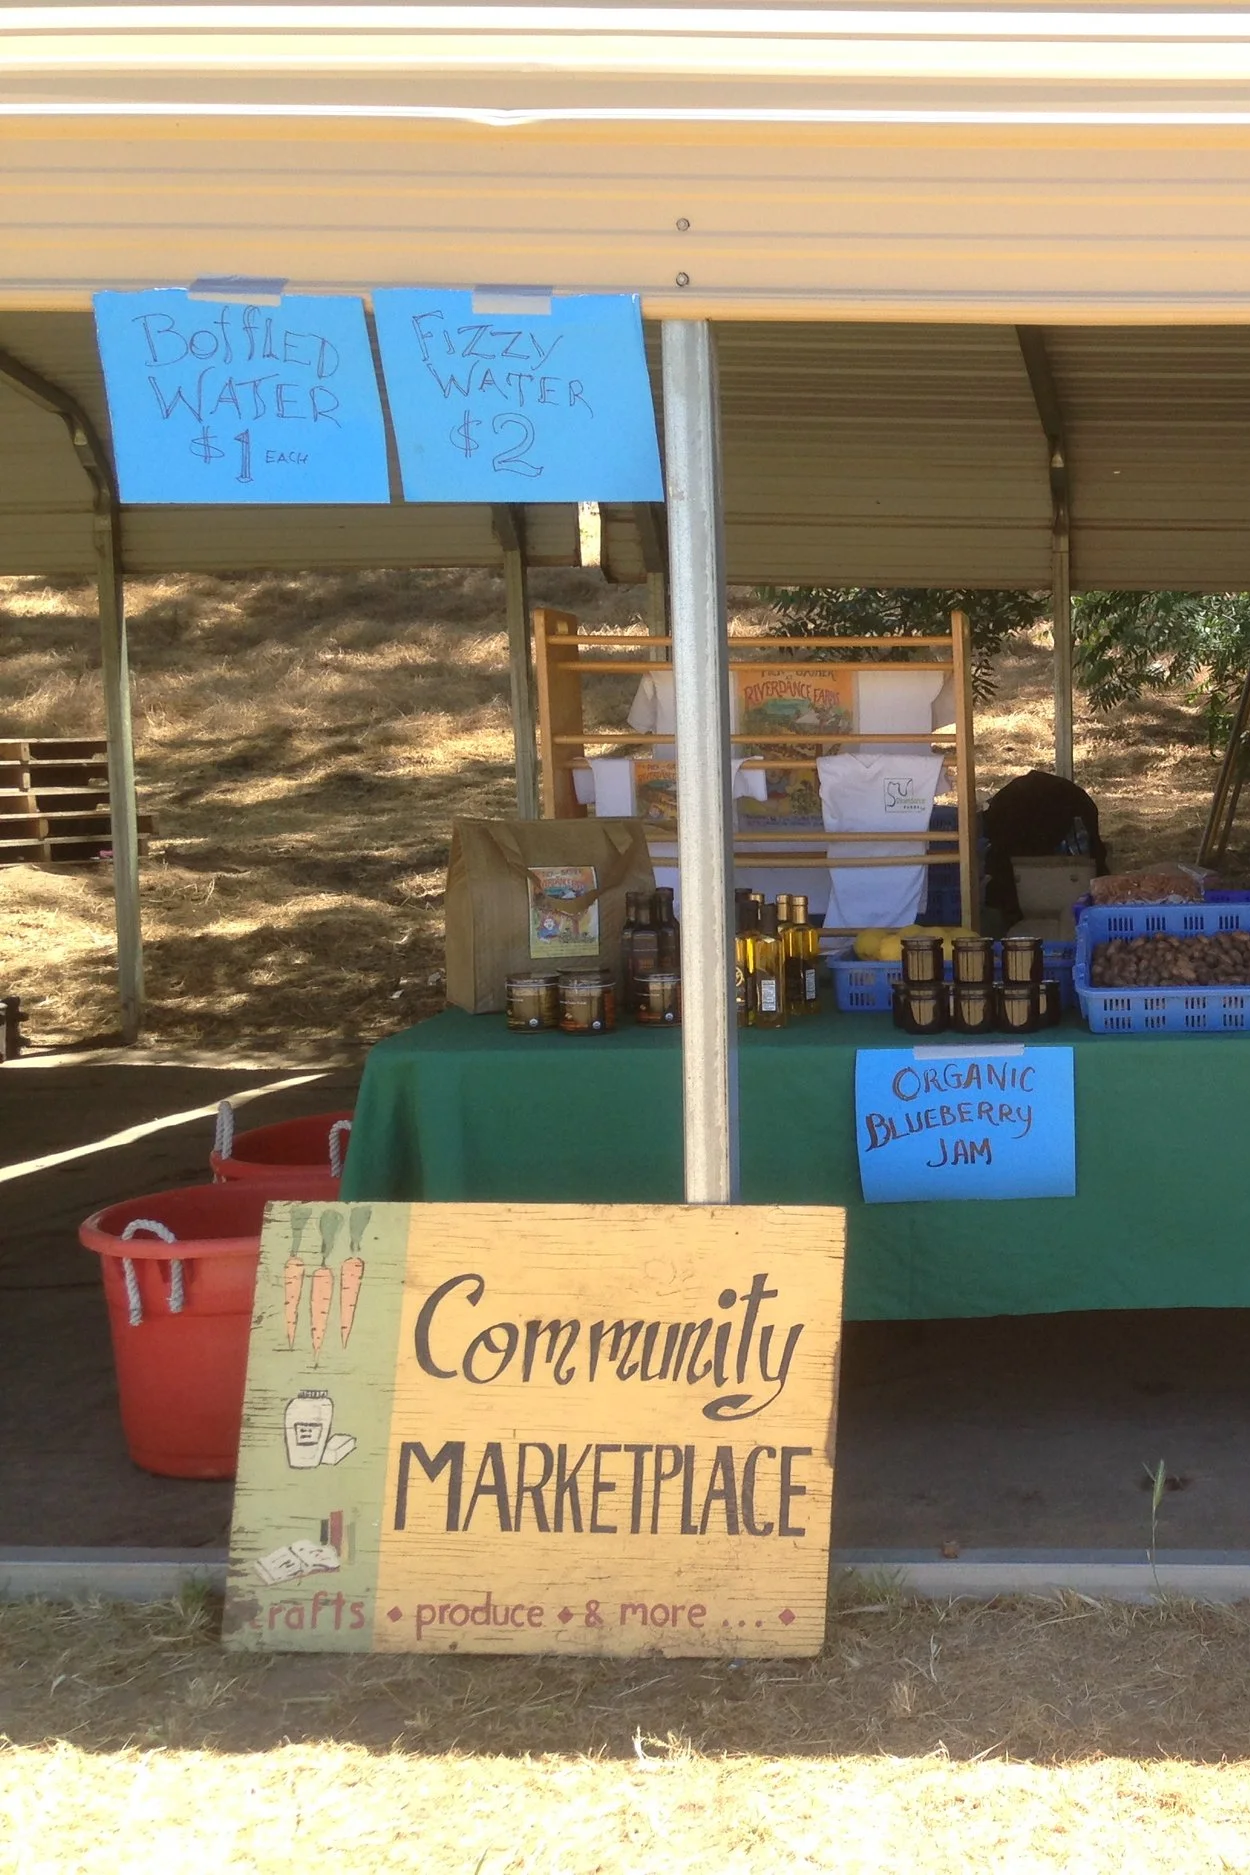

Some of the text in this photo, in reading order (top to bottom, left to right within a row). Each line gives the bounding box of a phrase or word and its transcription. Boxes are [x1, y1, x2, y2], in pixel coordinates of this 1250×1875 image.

[148, 367, 343, 428] WATER
[426, 361, 594, 418] WATER
[190, 425, 308, 484] $1 EACH
[449, 409, 544, 478] $2
[892, 1062, 1036, 1101] ORGANIC
[926, 1138, 992, 1168] JAM
[414, 1273, 804, 1421] Community
[394, 1441, 813, 1536] MARKETPLACE
[416, 1591, 545, 1641] produce
[584, 1600, 604, 1628] &
